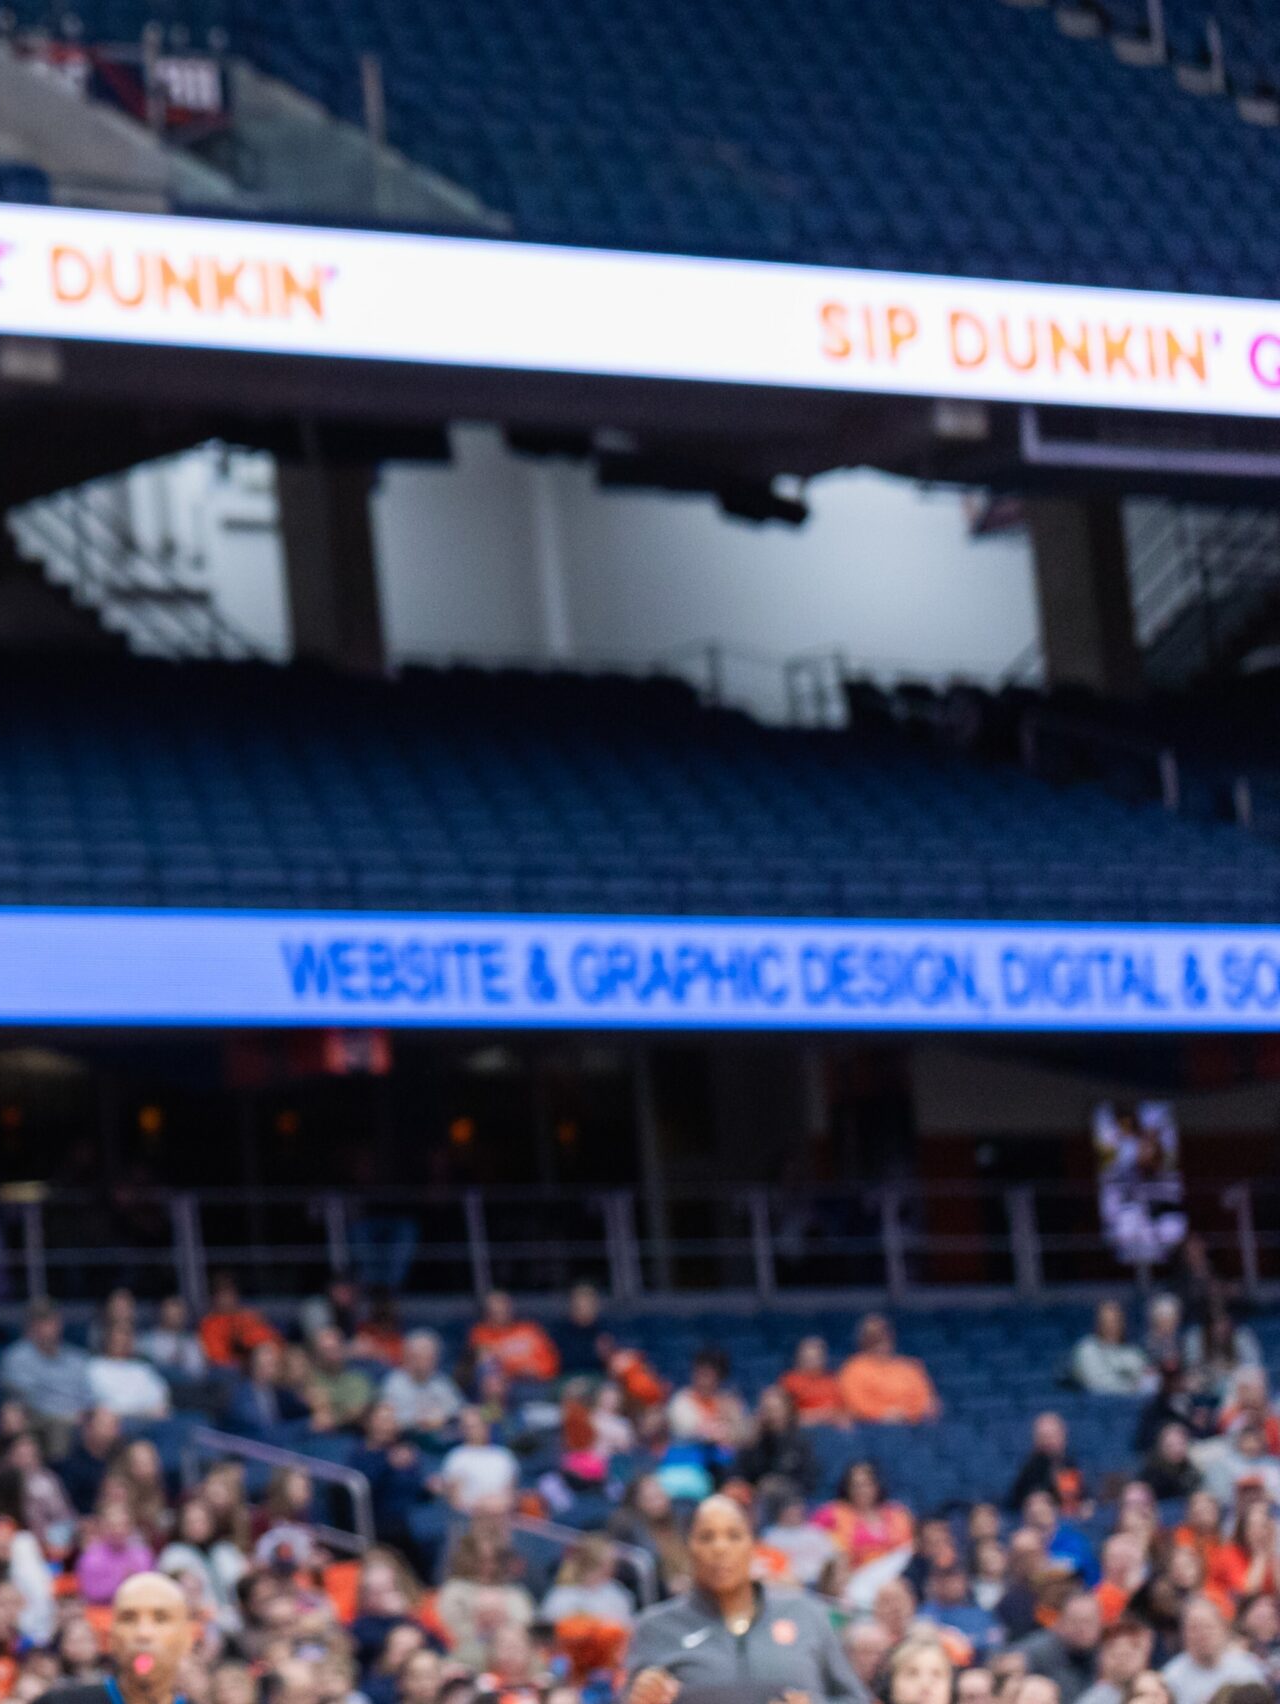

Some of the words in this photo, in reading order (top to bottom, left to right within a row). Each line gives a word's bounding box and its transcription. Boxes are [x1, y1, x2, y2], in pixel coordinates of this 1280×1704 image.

[821, 300, 919, 365] SIP
[948, 308, 1221, 383] DUNKIN'
[279, 938, 511, 1003] WEBSITE
[526, 940, 558, 1004] &
[572, 940, 787, 1006] GRAPHIC
[1001, 946, 1168, 1009] DIGITAL
[1183, 950, 1211, 1010] &
